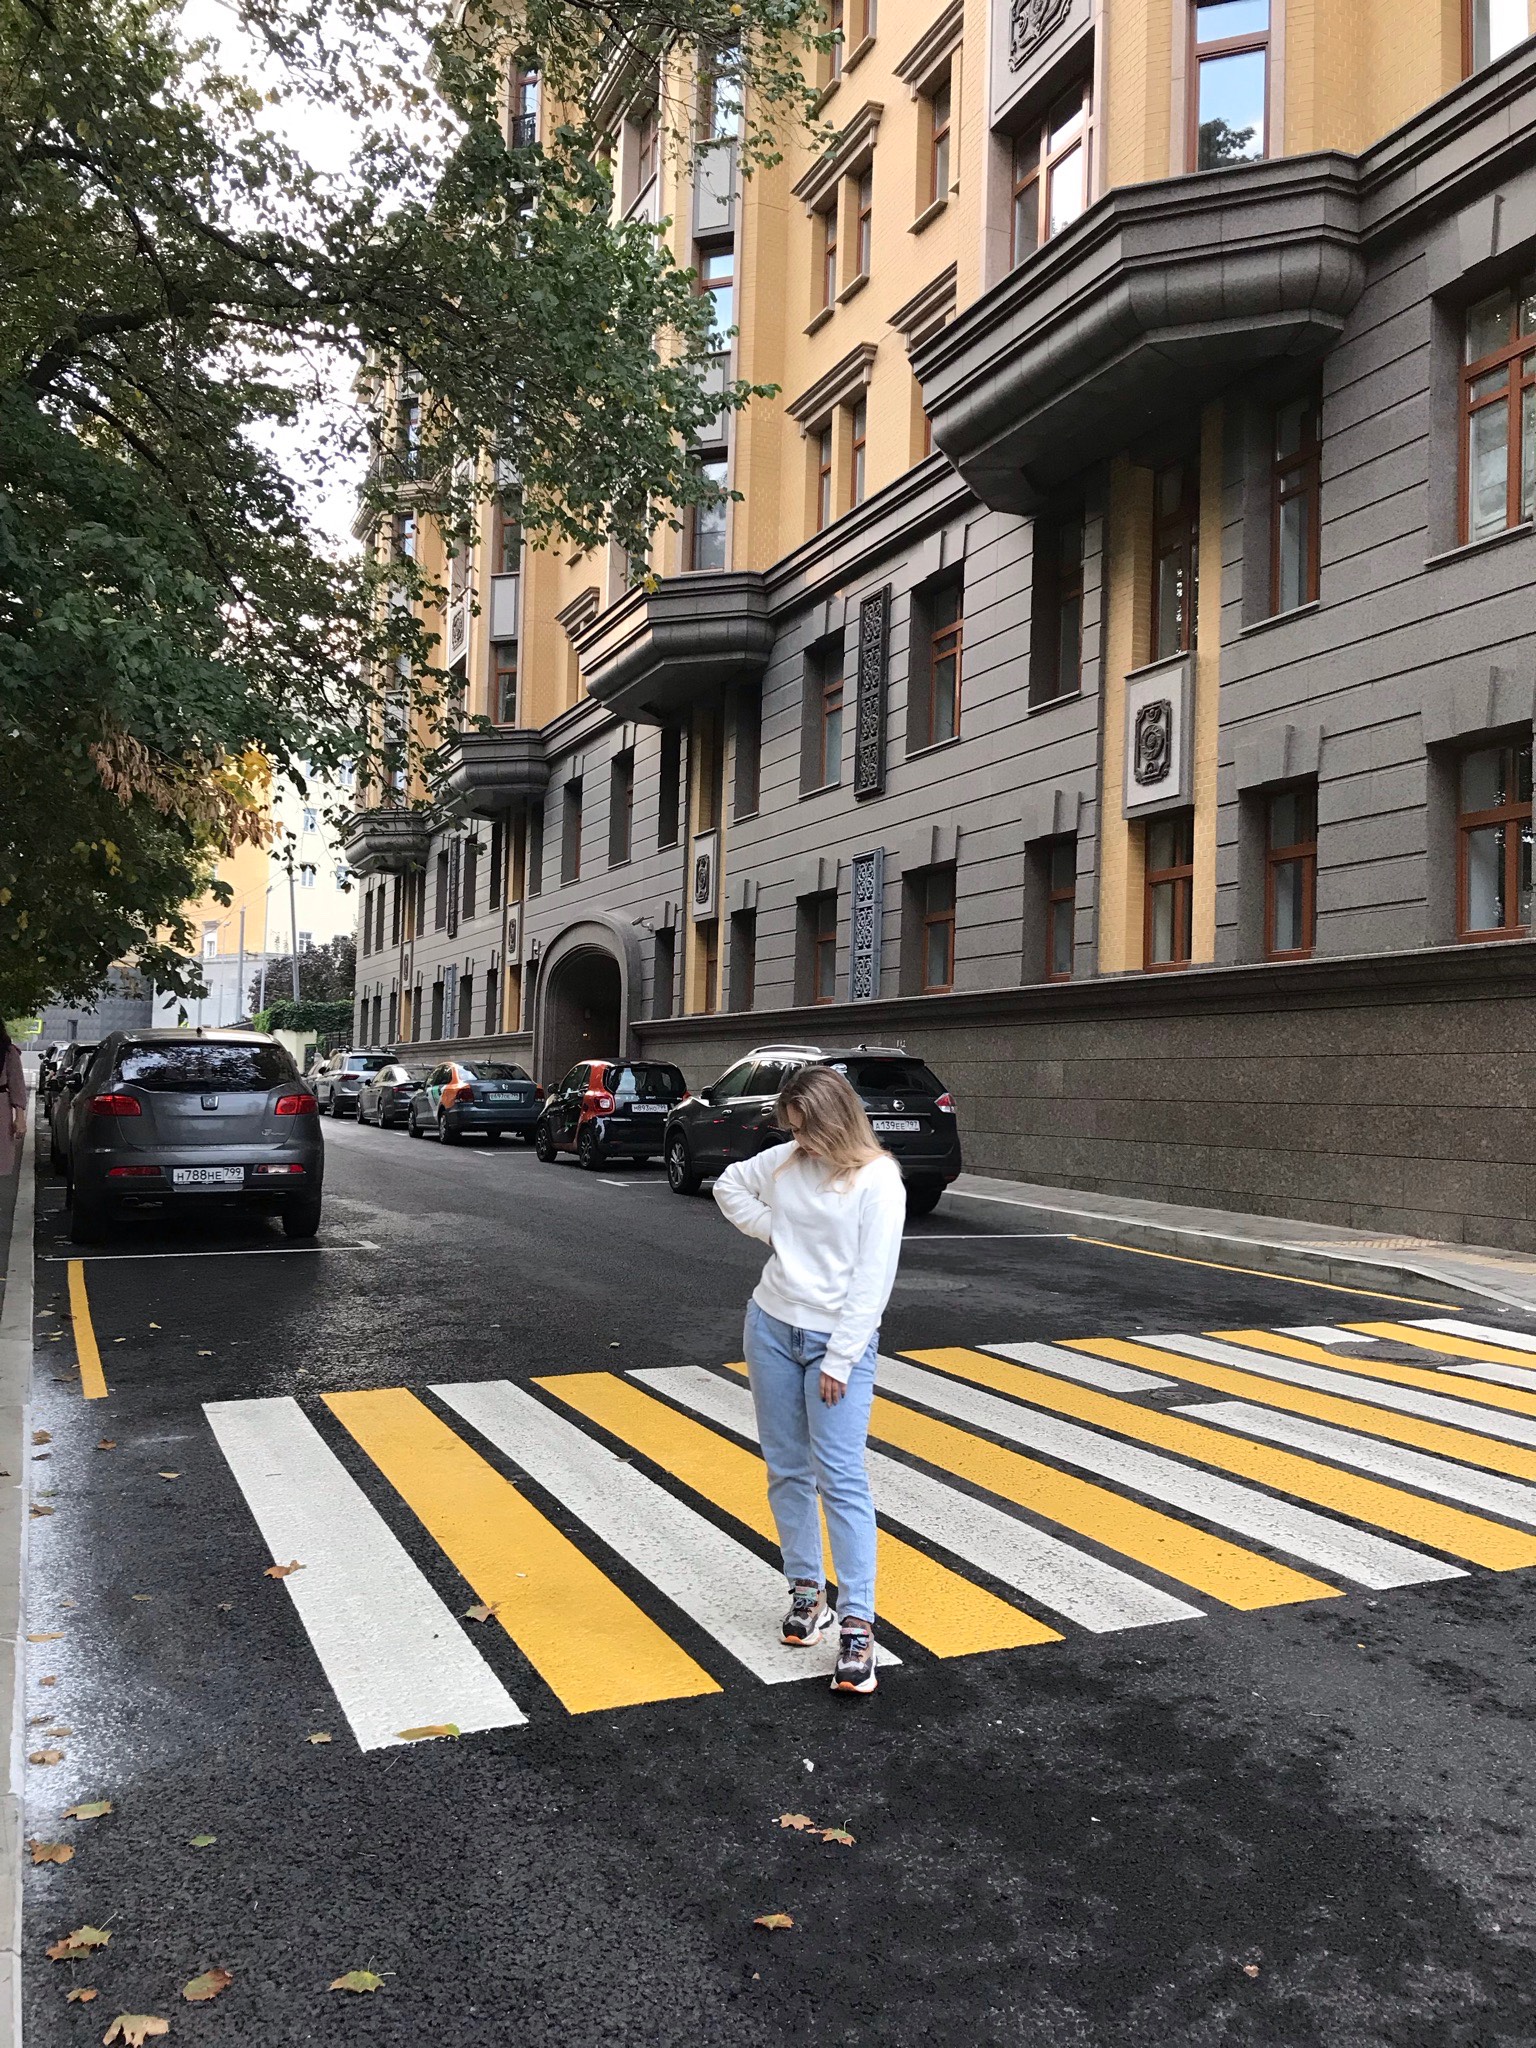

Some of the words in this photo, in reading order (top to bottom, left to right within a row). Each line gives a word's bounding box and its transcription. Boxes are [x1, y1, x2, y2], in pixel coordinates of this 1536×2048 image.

[906, 1120, 918, 1128] 797
[176, 1169, 222, 1181] Н788НЕ
[224, 1167, 242, 1177] 799
